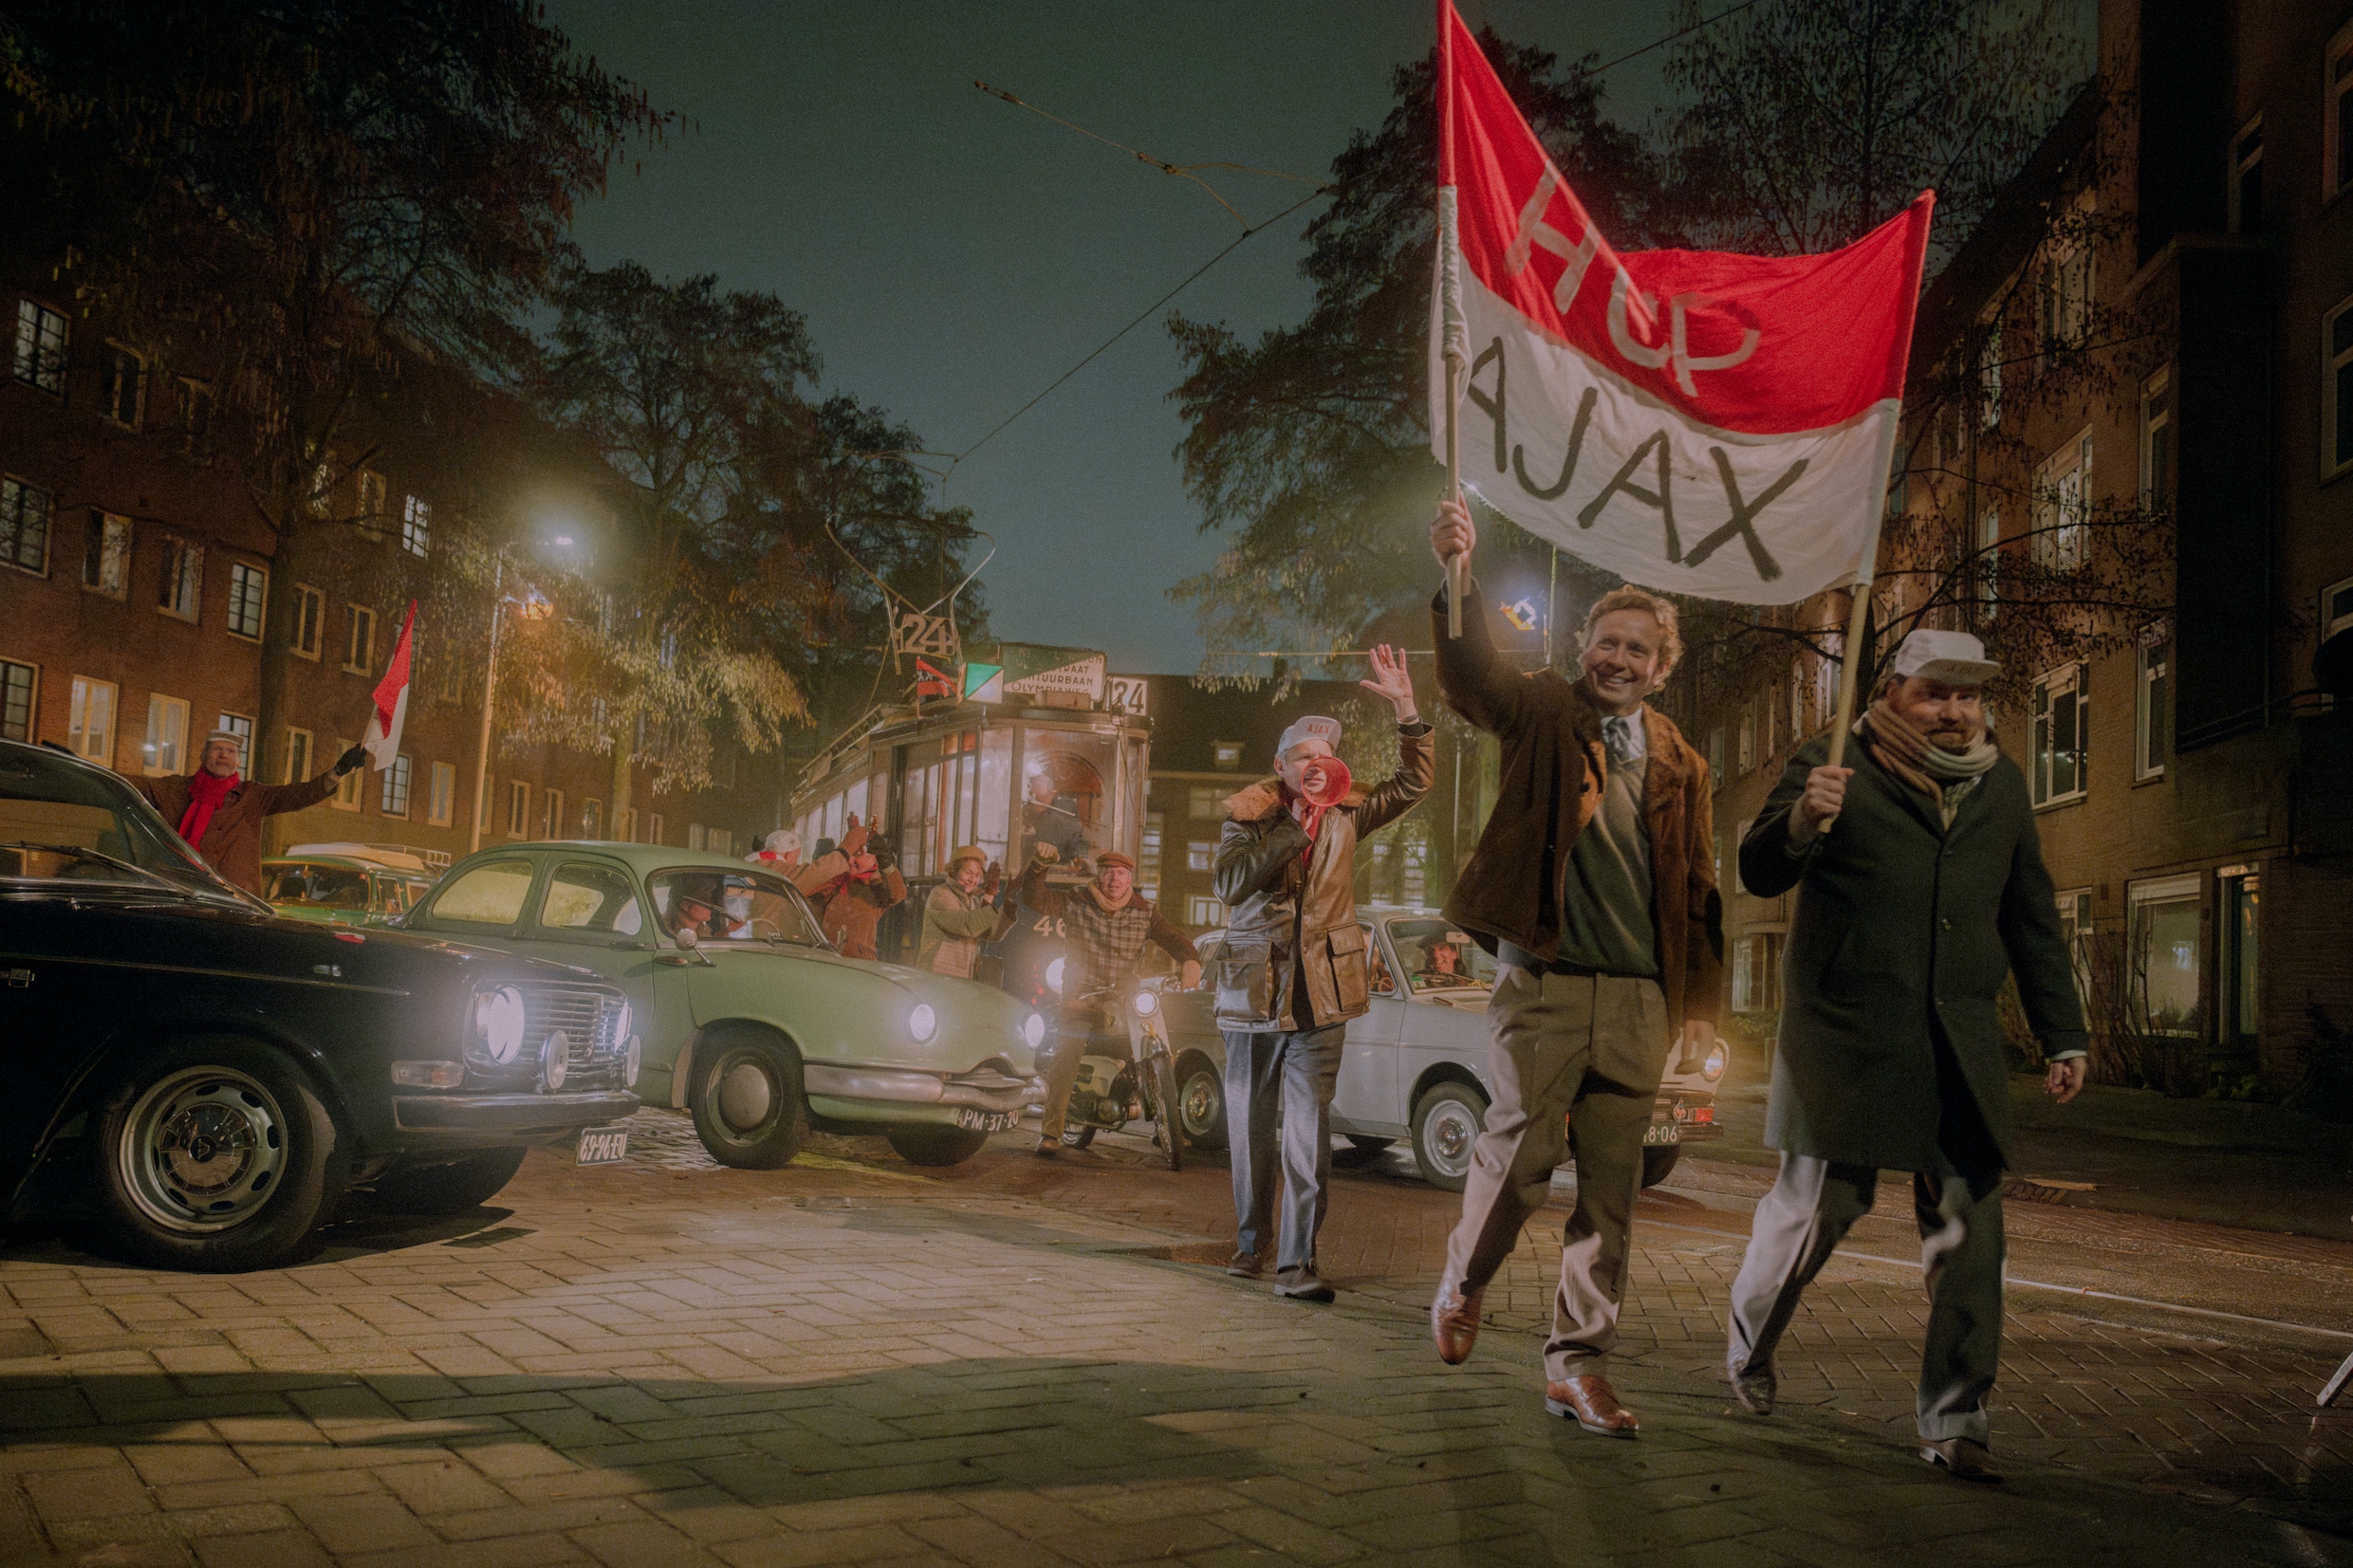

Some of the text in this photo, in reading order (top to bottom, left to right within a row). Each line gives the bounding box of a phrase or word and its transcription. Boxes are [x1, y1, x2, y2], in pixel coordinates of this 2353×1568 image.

[1467, 337, 1809, 581] AJAX
[903, 614, 954, 655] 24
[1113, 680, 1144, 714] 24
[1306, 723, 1330, 734] AJAX
[963, 1108, 1019, 1132] PM-37-20
[1643, 1125, 1677, 1143] 8-06
